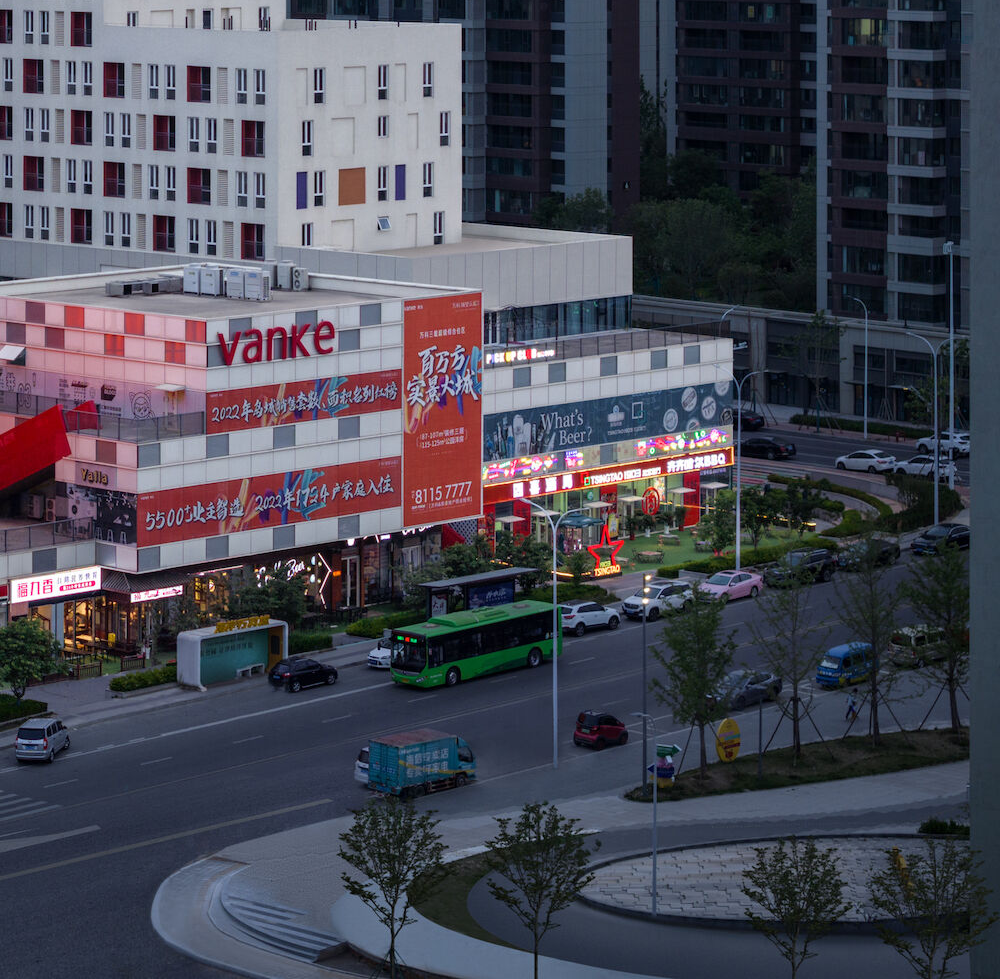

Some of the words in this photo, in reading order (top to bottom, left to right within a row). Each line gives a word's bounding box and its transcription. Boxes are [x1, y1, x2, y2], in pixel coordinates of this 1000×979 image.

[217, 320, 335, 366] vanke
[559, 426, 593, 446] Beer?
[590, 471, 623, 486] TSINGTAO
[415, 486, 442, 504] 8115
[445, 481, 472, 499] 7777
[594, 564, 621, 577] TSINGTAO
